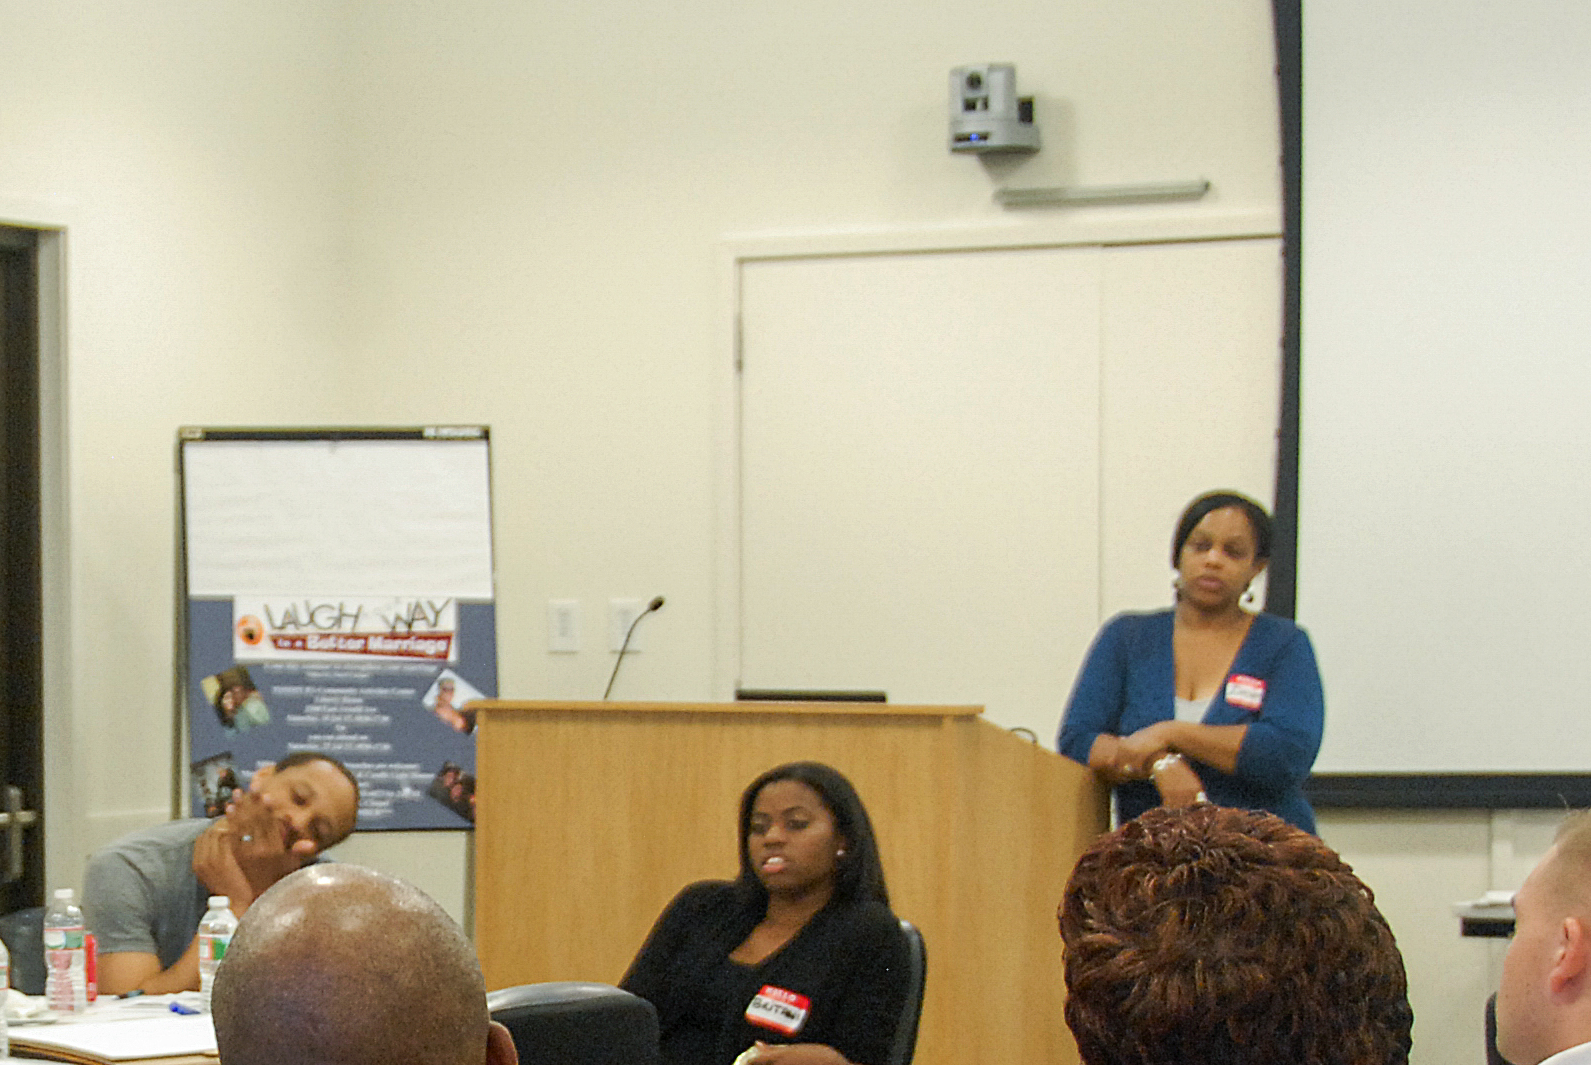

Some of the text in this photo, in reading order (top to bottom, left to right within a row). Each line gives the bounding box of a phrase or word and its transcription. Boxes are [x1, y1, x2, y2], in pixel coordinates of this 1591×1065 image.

[263, 599, 363, 633] LAUGH
[381, 597, 452, 633] WAY
[307, 634, 366, 651] Better
[368, 636, 447, 654] Marriage
